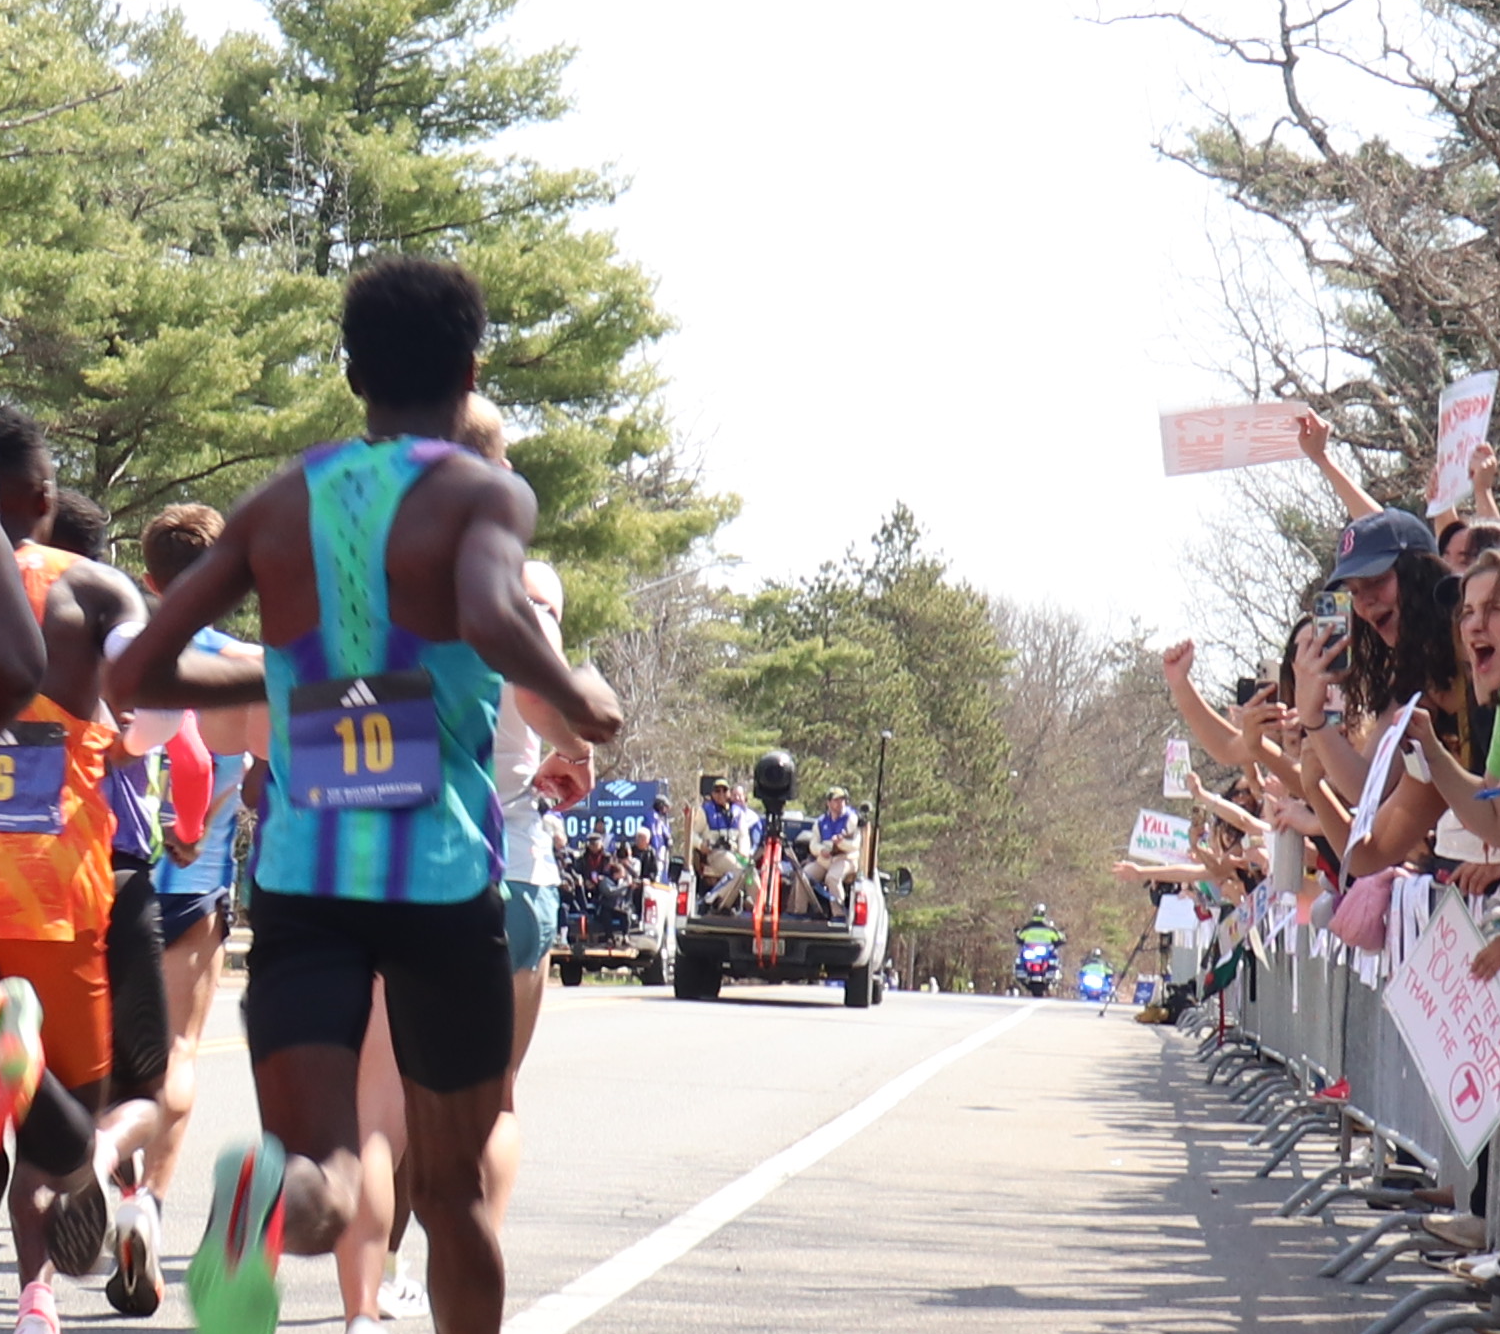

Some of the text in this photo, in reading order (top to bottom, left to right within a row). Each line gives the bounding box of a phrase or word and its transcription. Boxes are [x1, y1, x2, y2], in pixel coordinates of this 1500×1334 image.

[334, 713, 394, 775] 10
[1436, 916, 1458, 952] NO
[1404, 967, 1438, 1019] THAN
[1436, 1018, 1458, 1059] THE
[1426, 938, 1473, 1025] YOU'RE
